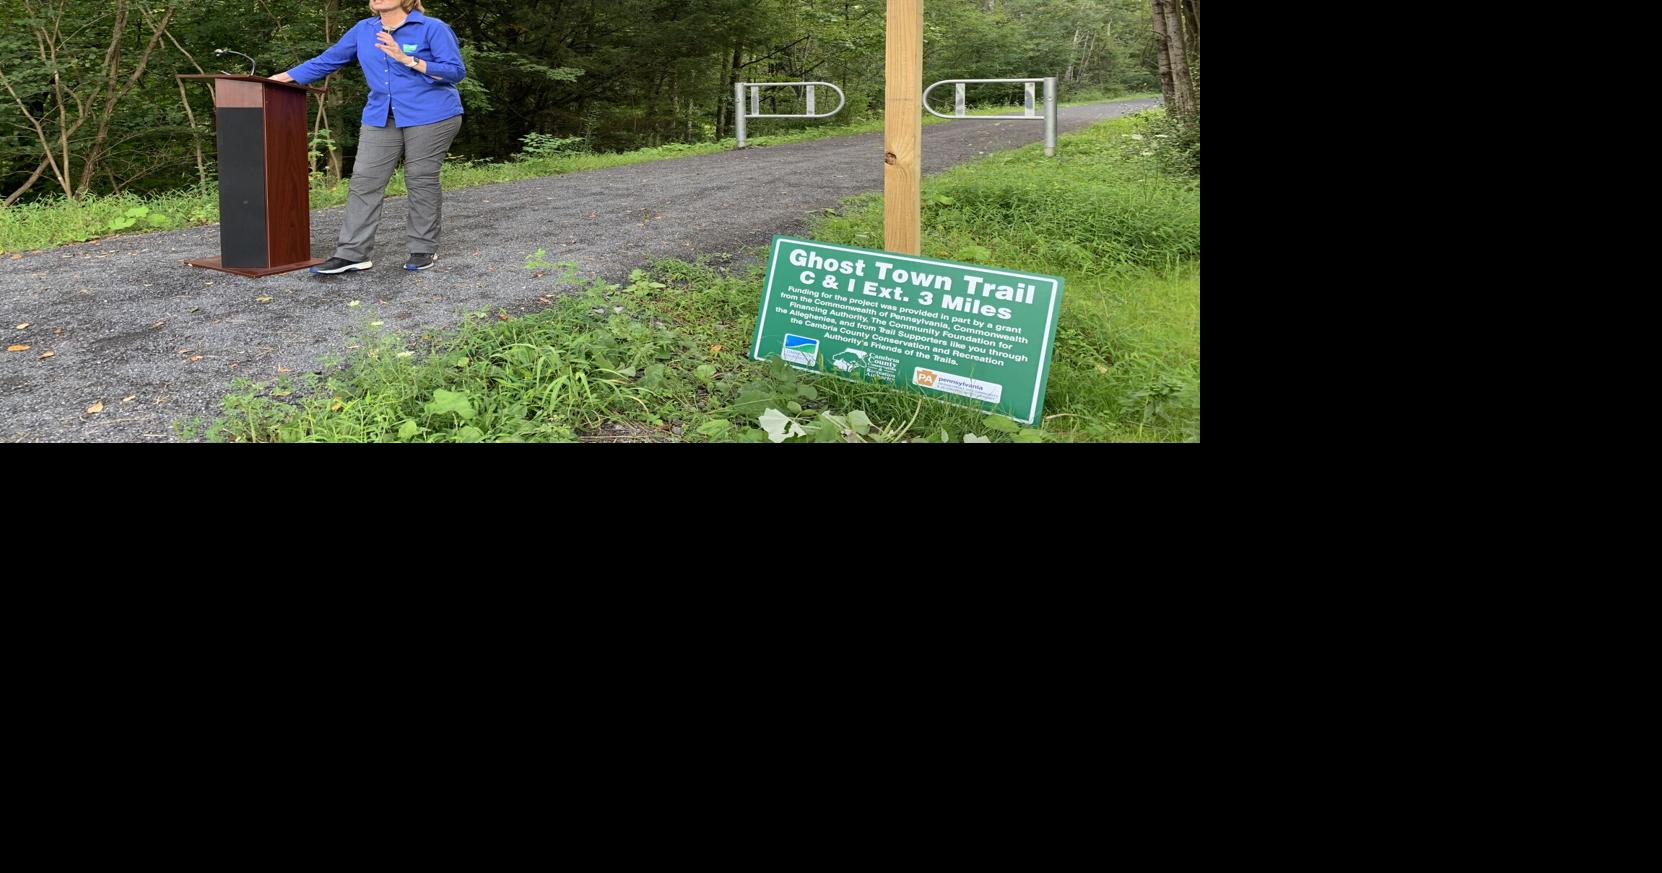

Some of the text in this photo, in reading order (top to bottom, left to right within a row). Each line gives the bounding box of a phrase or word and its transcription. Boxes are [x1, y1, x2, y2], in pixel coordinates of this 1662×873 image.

[789, 248, 1036, 304] Ghost Town Trail
[799, 270, 1012, 319] C & I Ext. 3 Miles
[780, 292, 798, 300] from
[799, 295, 813, 303] the
[814, 298, 877, 315] Commonwealth
[890, 312, 950, 330] Pennsylvania,
[953, 324, 1028, 344] Commonwealth
[787, 285, 819, 298] Funding
[834, 294, 848, 302] the
[849, 298, 878, 307] project
[880, 303, 897, 311] was
[899, 307, 939, 318] provided
[951, 316, 971, 324] part
[972, 319, 985, 328] by
[995, 324, 1022, 334] grant
[789, 301, 828, 315] Financing
[872, 317, 887, 325] The
[888, 320, 940, 337] Community
[942, 330, 996, 347] Foundation
[998, 341, 1013, 350] for
[789, 309, 837, 324] Alleghenies,
[857, 322, 876, 331] from
[878, 326, 896, 335] Trail
[897, 330, 947, 346] Supporters
[949, 340, 966, 350] like
[968, 345, 986, 354] you
[988, 348, 1028, 362] through
[804, 320, 838, 332] Cambria
[839, 327, 870, 339] County
[871, 333, 930, 351] Conservation
[932, 347, 950, 355] and
[952, 349, 1004, 366] Recreation
[870, 341, 902, 353] Friends
[915, 351, 930, 359] the
[933, 354, 958, 366] Trails.
[867, 356, 897, 368] County
[918, 373, 933, 383] PA
[938, 377, 984, 391] pennsylvania
